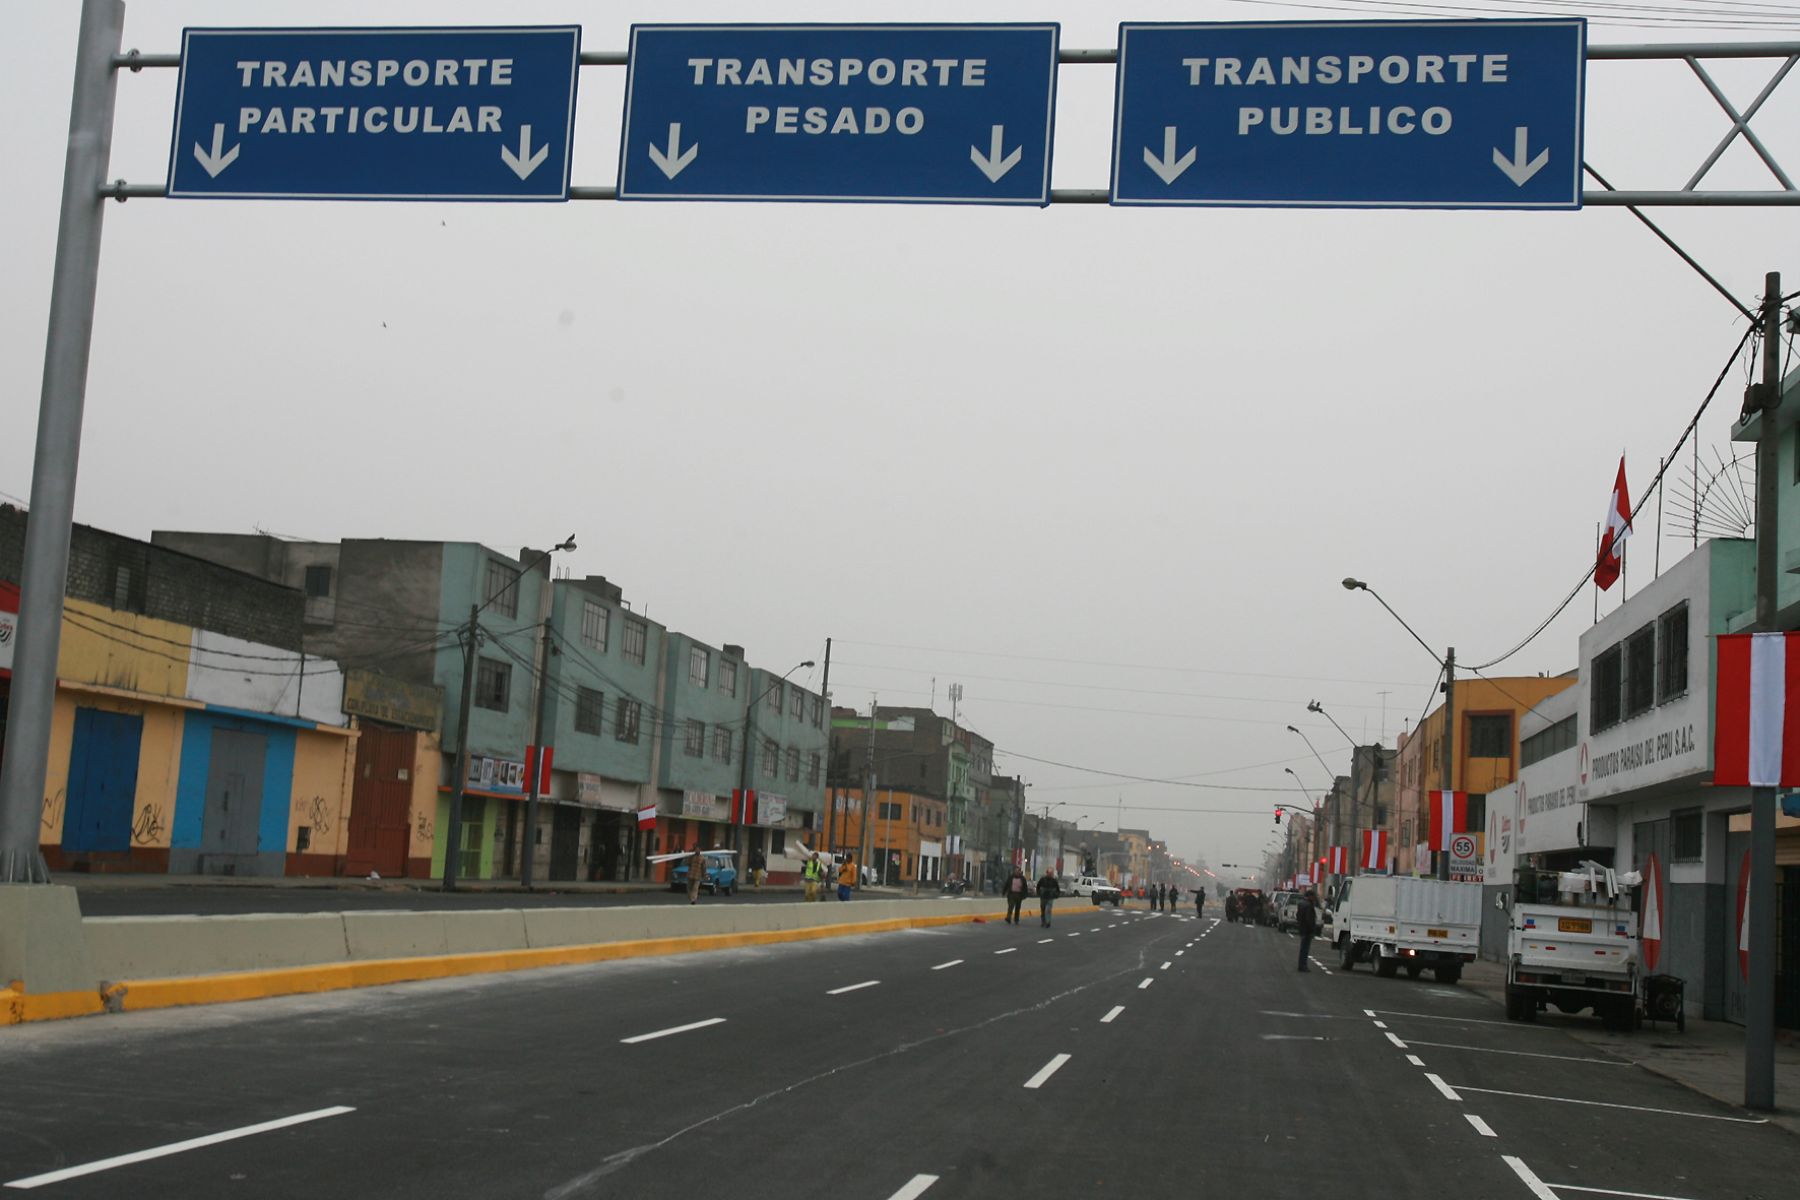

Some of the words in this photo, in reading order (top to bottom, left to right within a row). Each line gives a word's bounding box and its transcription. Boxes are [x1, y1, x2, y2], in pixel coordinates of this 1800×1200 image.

[236, 58, 514, 87] TRANSPORTE
[688, 58, 987, 86] TRANSPORTE
[1182, 54, 1509, 86] TRANSPORTE
[238, 105, 503, 134] PARTICULAR
[745, 106, 925, 135] PESADO
[1238, 106, 1453, 135] PUBLICO
[1592, 751, 1619, 780] PRODUCTOS
[1620, 742, 1643, 772] PARAISO
[1645, 738, 1655, 765] DEL
[1657, 731, 1673, 761] PERU
[1675, 724, 1695, 756] S.A.C.
[1456, 842, 1470, 852] 55
[1451, 865, 1475, 873] MAXIMA
